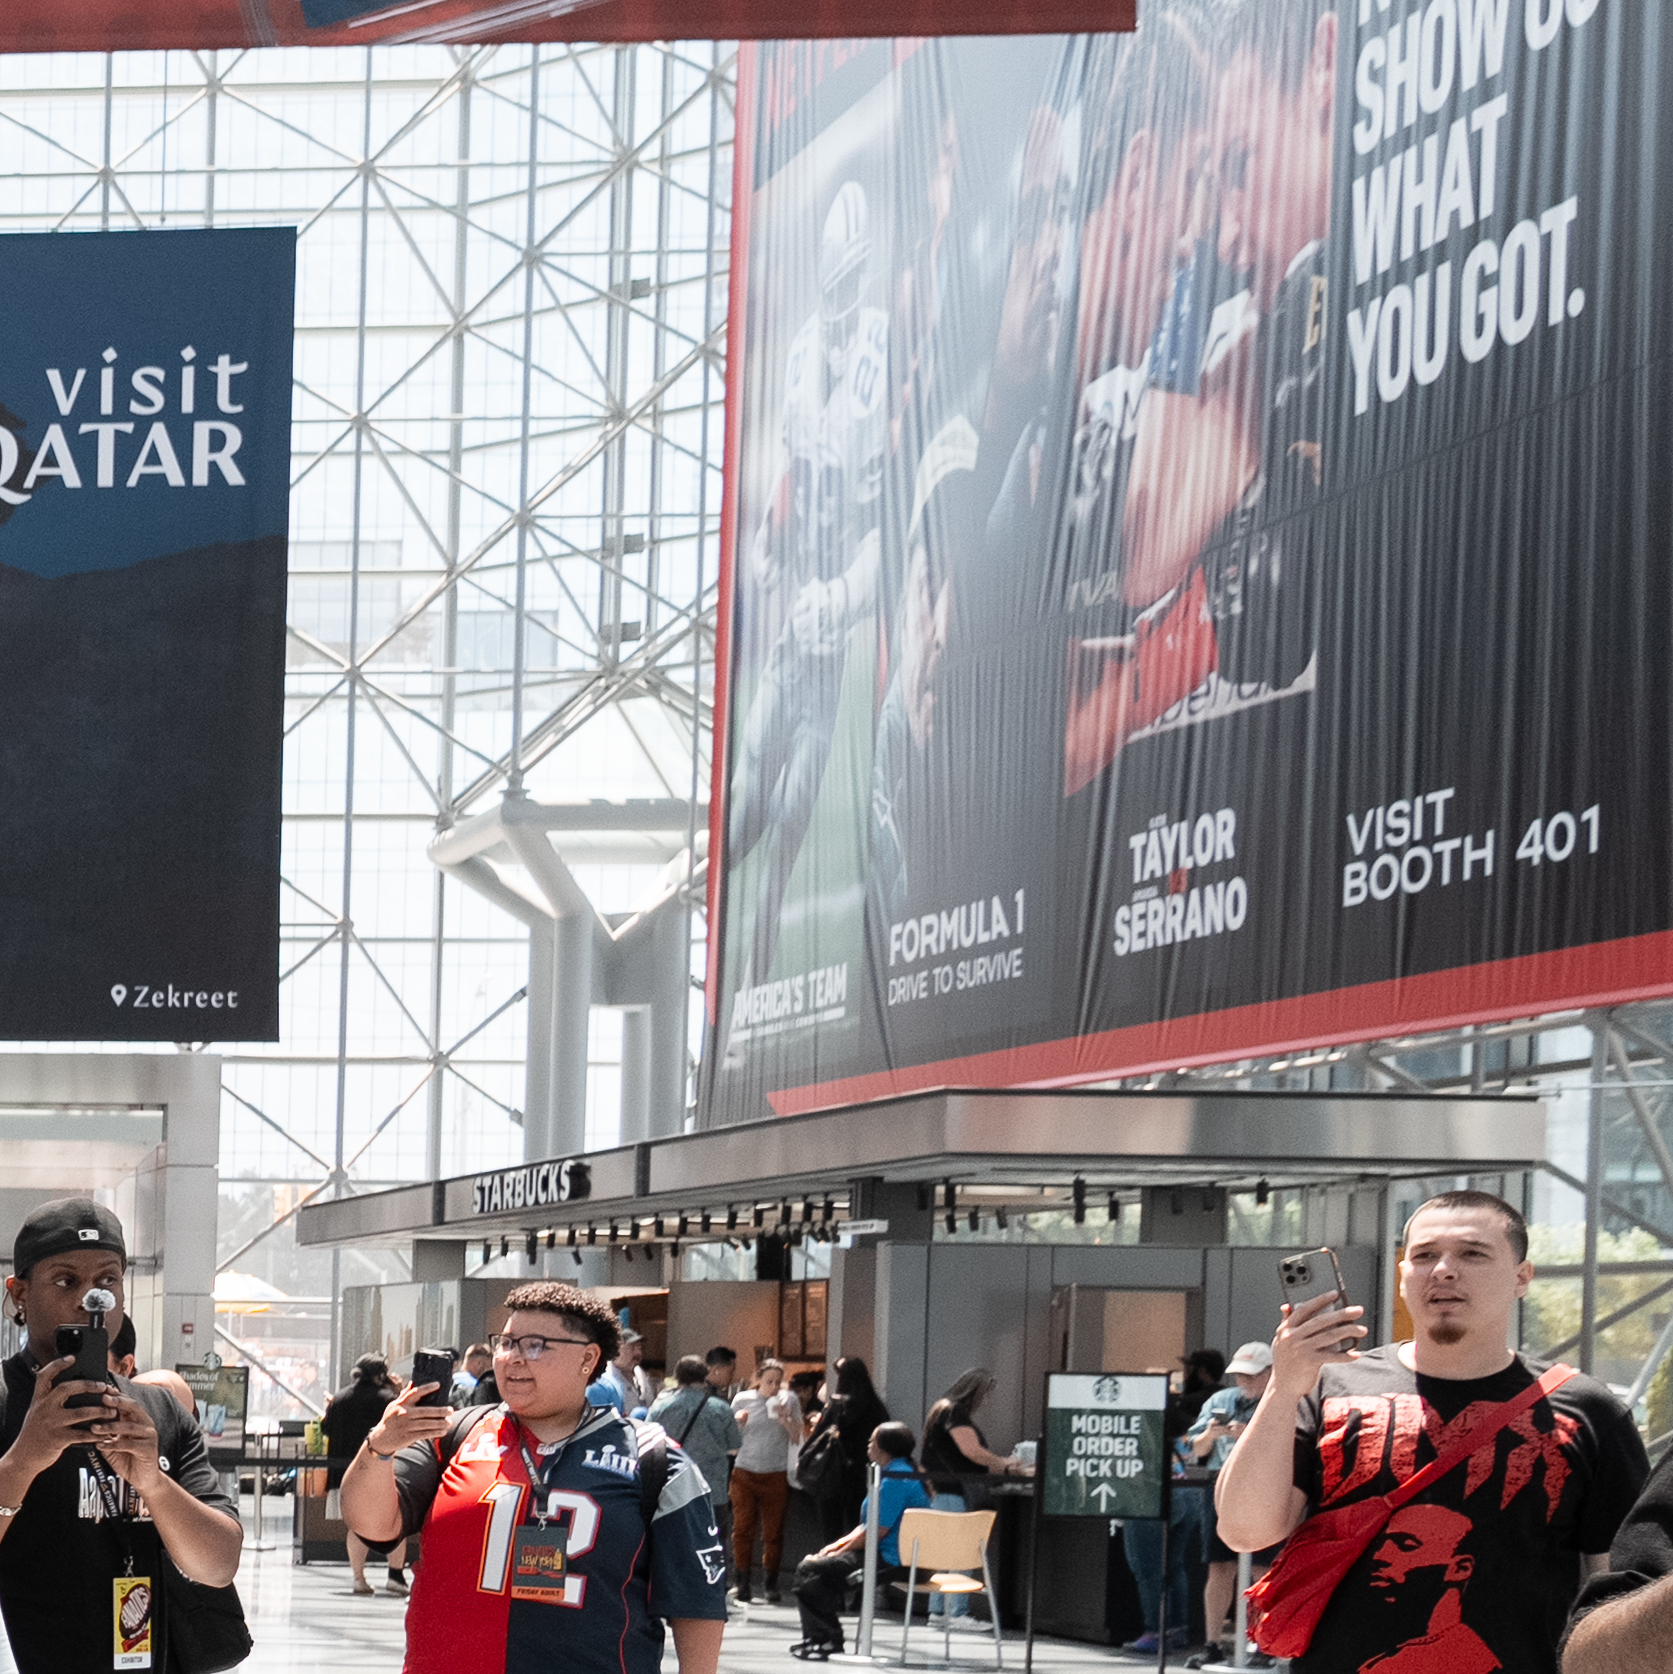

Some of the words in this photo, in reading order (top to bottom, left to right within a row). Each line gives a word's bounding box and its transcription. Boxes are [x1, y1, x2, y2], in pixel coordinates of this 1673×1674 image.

[1351, 92, 1508, 286] WHAT
[1346, 260, 1452, 417] YOU
[1459, 195, 1586, 364] GOT.
[45, 345, 249, 416] visit
[1129, 807, 1237, 884] TAYLOR
[1342, 828, 1495, 909] BOOTH
[1515, 803, 1601, 867] 401
[1346, 786, 1456, 857] VISIT
[888, 895, 1010, 967] FORMULA
[1014, 887, 1026, 935] 1
[1113, 875, 1248, 957] SERRANO
[133, 984, 239, 1009] Zekreet
[807, 962, 849, 1009] TEAM
[887, 970, 928, 1006] DRIVE
[932, 965, 953, 995] TO
[955, 947, 1024, 990] SURVIVE
[472, 1159, 572, 1214] STARBUCKS
[1071, 1414, 1142, 1435] MOBILE
[1072, 1436, 1139, 1456] ORDER
[1065, 1458, 1113, 1478] PICK
[1116, 1459, 1145, 1478] UP
[477, 1481, 601, 1609] 12
